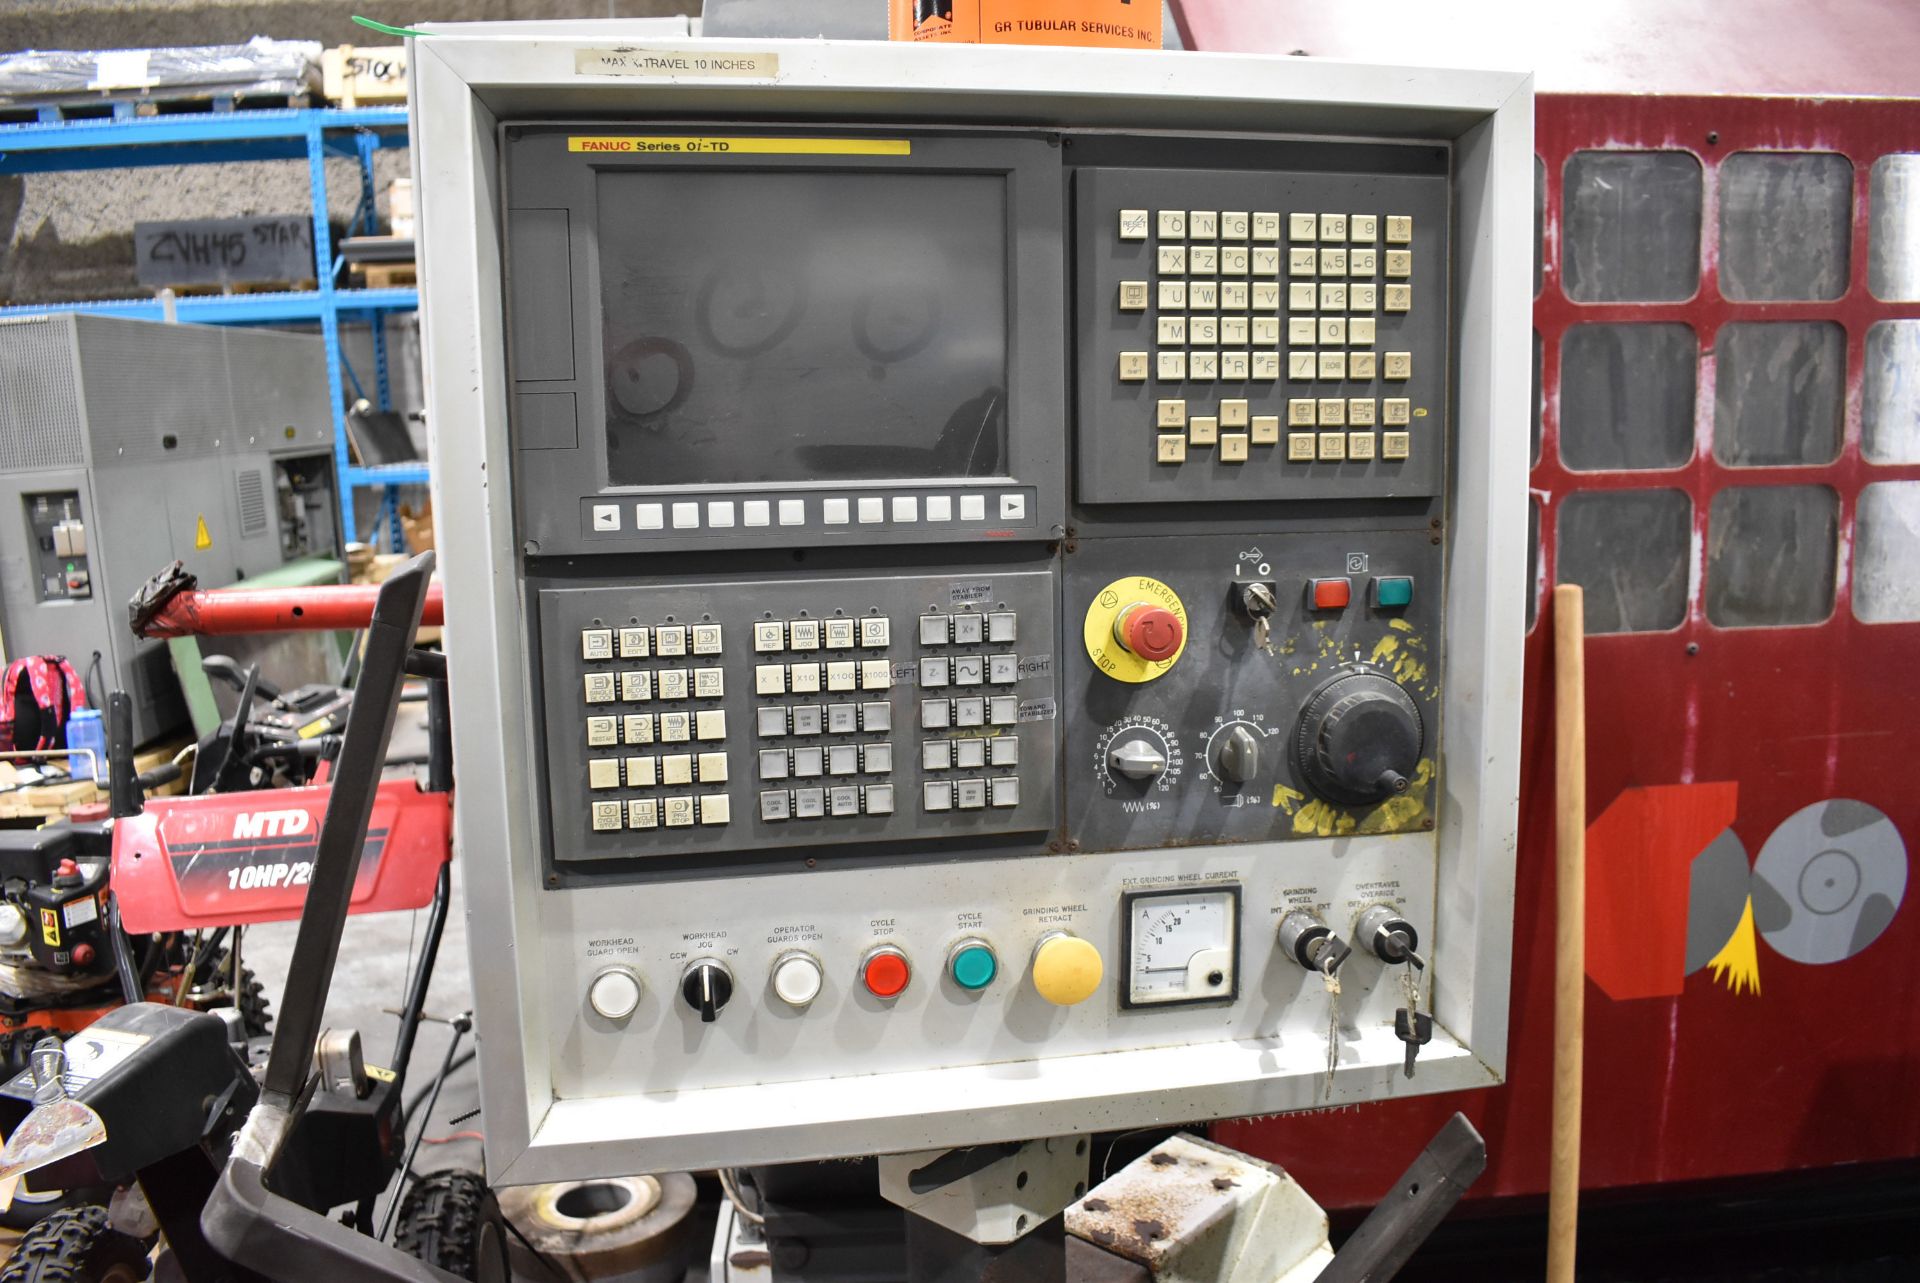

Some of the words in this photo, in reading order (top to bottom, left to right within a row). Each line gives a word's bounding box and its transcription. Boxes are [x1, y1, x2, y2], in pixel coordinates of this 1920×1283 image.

[995, 22, 1012, 32] GR
[1017, 20, 1075, 31] TUBULAR
[1082, 21, 1134, 38] SERVICES
[601, 57, 626, 66] MAX
[644, 58, 689, 69] TRAVEL
[694, 60, 706, 69] 10
[711, 60, 755, 70] INCHES
[582, 142, 631, 150] FANUC
[637, 142, 681, 151] Series
[1204, 220, 1214, 232] N
[1235, 221, 1245, 233] G
[1266, 221, 1275, 232] P
[1304, 221, 1313, 232] 7
[1335, 222, 1344, 233] 8
[1366, 222, 1374, 234] 9
[1172, 256, 1182, 267] X
[1204, 256, 1214, 267] Z
[1234, 256, 1245, 268] C
[1266, 257, 1275, 268] Y
[1304, 256, 1313, 267] 4
[1335, 256, 1344, 268] 5
[1365, 256, 1374, 268] 6
[1173, 291, 1182, 302] U
[1202, 291, 1214, 303] W
[1235, 292, 1244, 303] H
[1266, 292, 1275, 303] V
[1306, 290, 1311, 301] 1
[1335, 290, 1344, 302] 2
[1364, 291, 1374, 302] 3
[1171, 326, 1182, 337] M
[1203, 326, 1213, 337] S
[1235, 326, 1244, 337] T
[1266, 326, 1275, 338] L
[1204, 361, 1213, 372] K
[1235, 361, 1244, 372] R
[1267, 361, 1275, 372] F
[1139, 579, 1185, 629] EMERGENC
[1092, 648, 1115, 671] STOP
[1018, 662, 1049, 672] RIGHT
[891, 669, 914, 678] LEFT
[233, 810, 309, 839] MTD
[1205, 871, 1237, 879] CURRENT
[1283, 888, 1317, 896] GRINDING
[1023, 906, 1059, 915] GRINDING
[1062, 904, 1088, 912] WHEEL
[1143, 910, 1149, 919] A
[1039, 915, 1072, 923] RETRACT
[774, 925, 815, 933] OPERATOR
[958, 921, 982, 929] START
[683, 931, 727, 940] WORKHEAD
[768, 935, 798, 943] GUARDS
[589, 938, 634, 947] WORKHEAD
